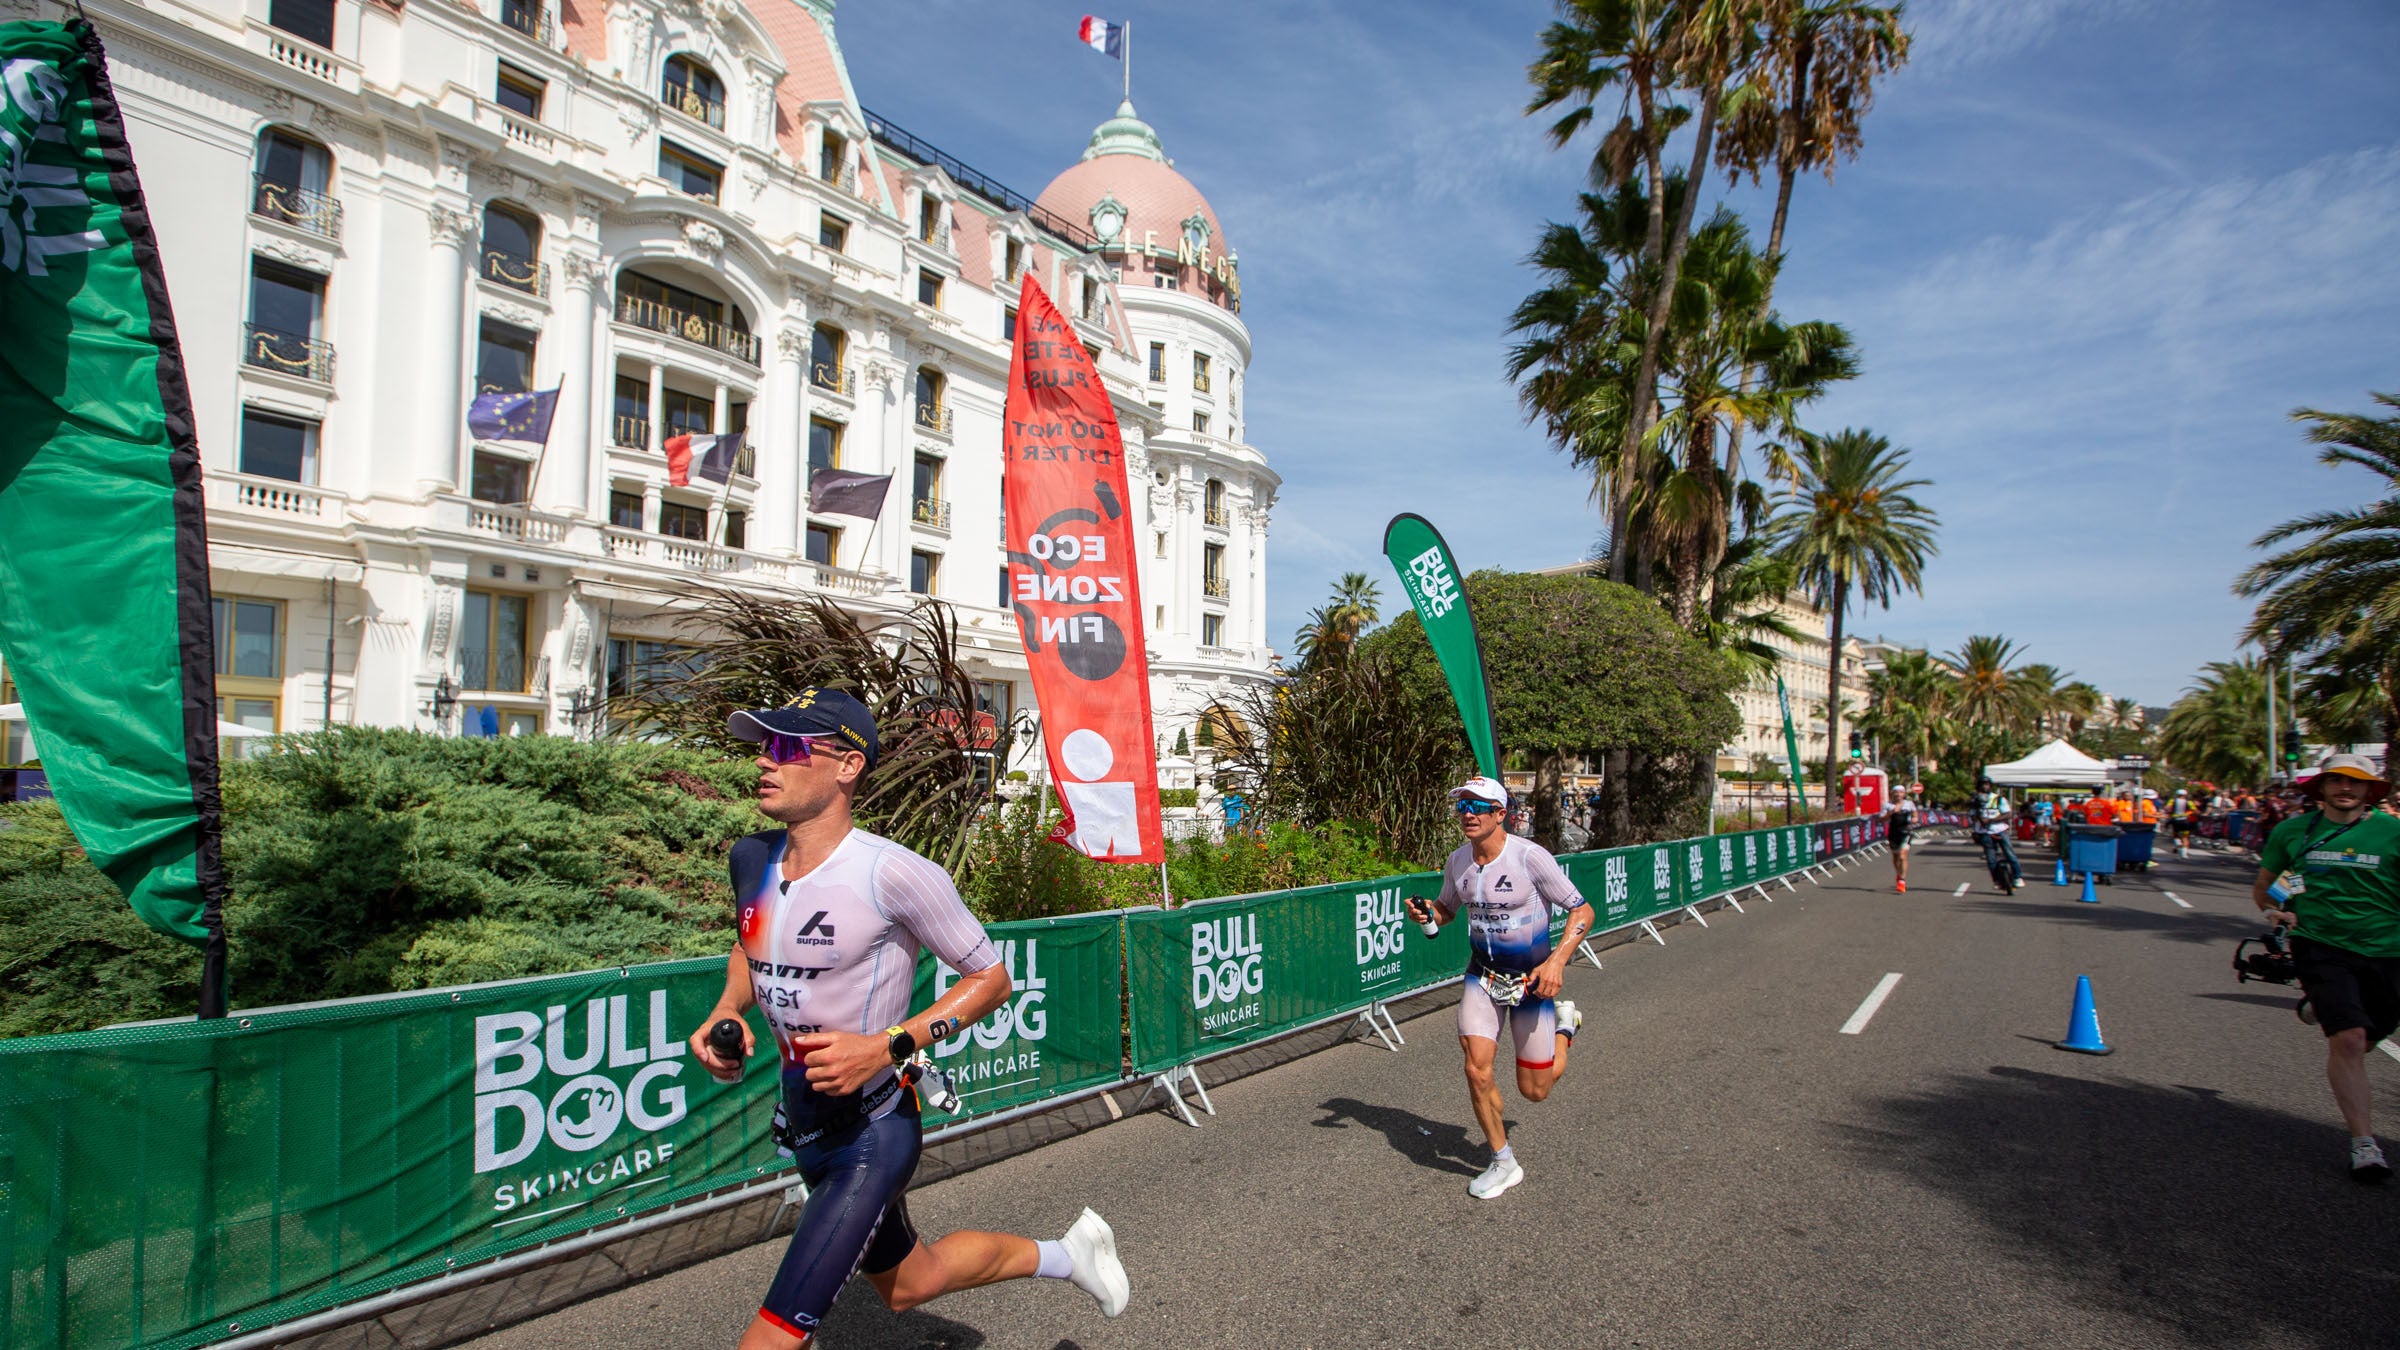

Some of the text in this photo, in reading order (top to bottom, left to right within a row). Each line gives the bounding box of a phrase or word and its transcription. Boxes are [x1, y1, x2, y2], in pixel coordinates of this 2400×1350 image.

[1124, 228, 1159, 257] LE
[1404, 569, 1434, 620] SKINCARE
[1409, 554, 1449, 618] DOG
[1423, 545, 1459, 611] BULL
[840, 725, 869, 749] TAIWAN
[1605, 856, 1627, 881] BULL
[1606, 878, 1628, 904] DOG
[1355, 886, 1404, 931] BULL
[796, 937, 835, 946] surpas
[1191, 913, 1263, 966] BULL
[1356, 920, 1404, 965] DOG
[1193, 954, 1263, 1010] DOG
[1361, 961, 1401, 983] SKINCARE
[758, 984, 800, 1009] AG1
[1203, 1002, 1259, 1031] SKINCARE
[475, 989, 686, 1094] BULL
[947, 1051, 1040, 1085] SKINCARE
[860, 1081, 898, 1114] deboer
[475, 1060, 687, 1174] DOG
[794, 1127, 825, 1147] deboer
[494, 1143, 674, 1211] SKINCARE
